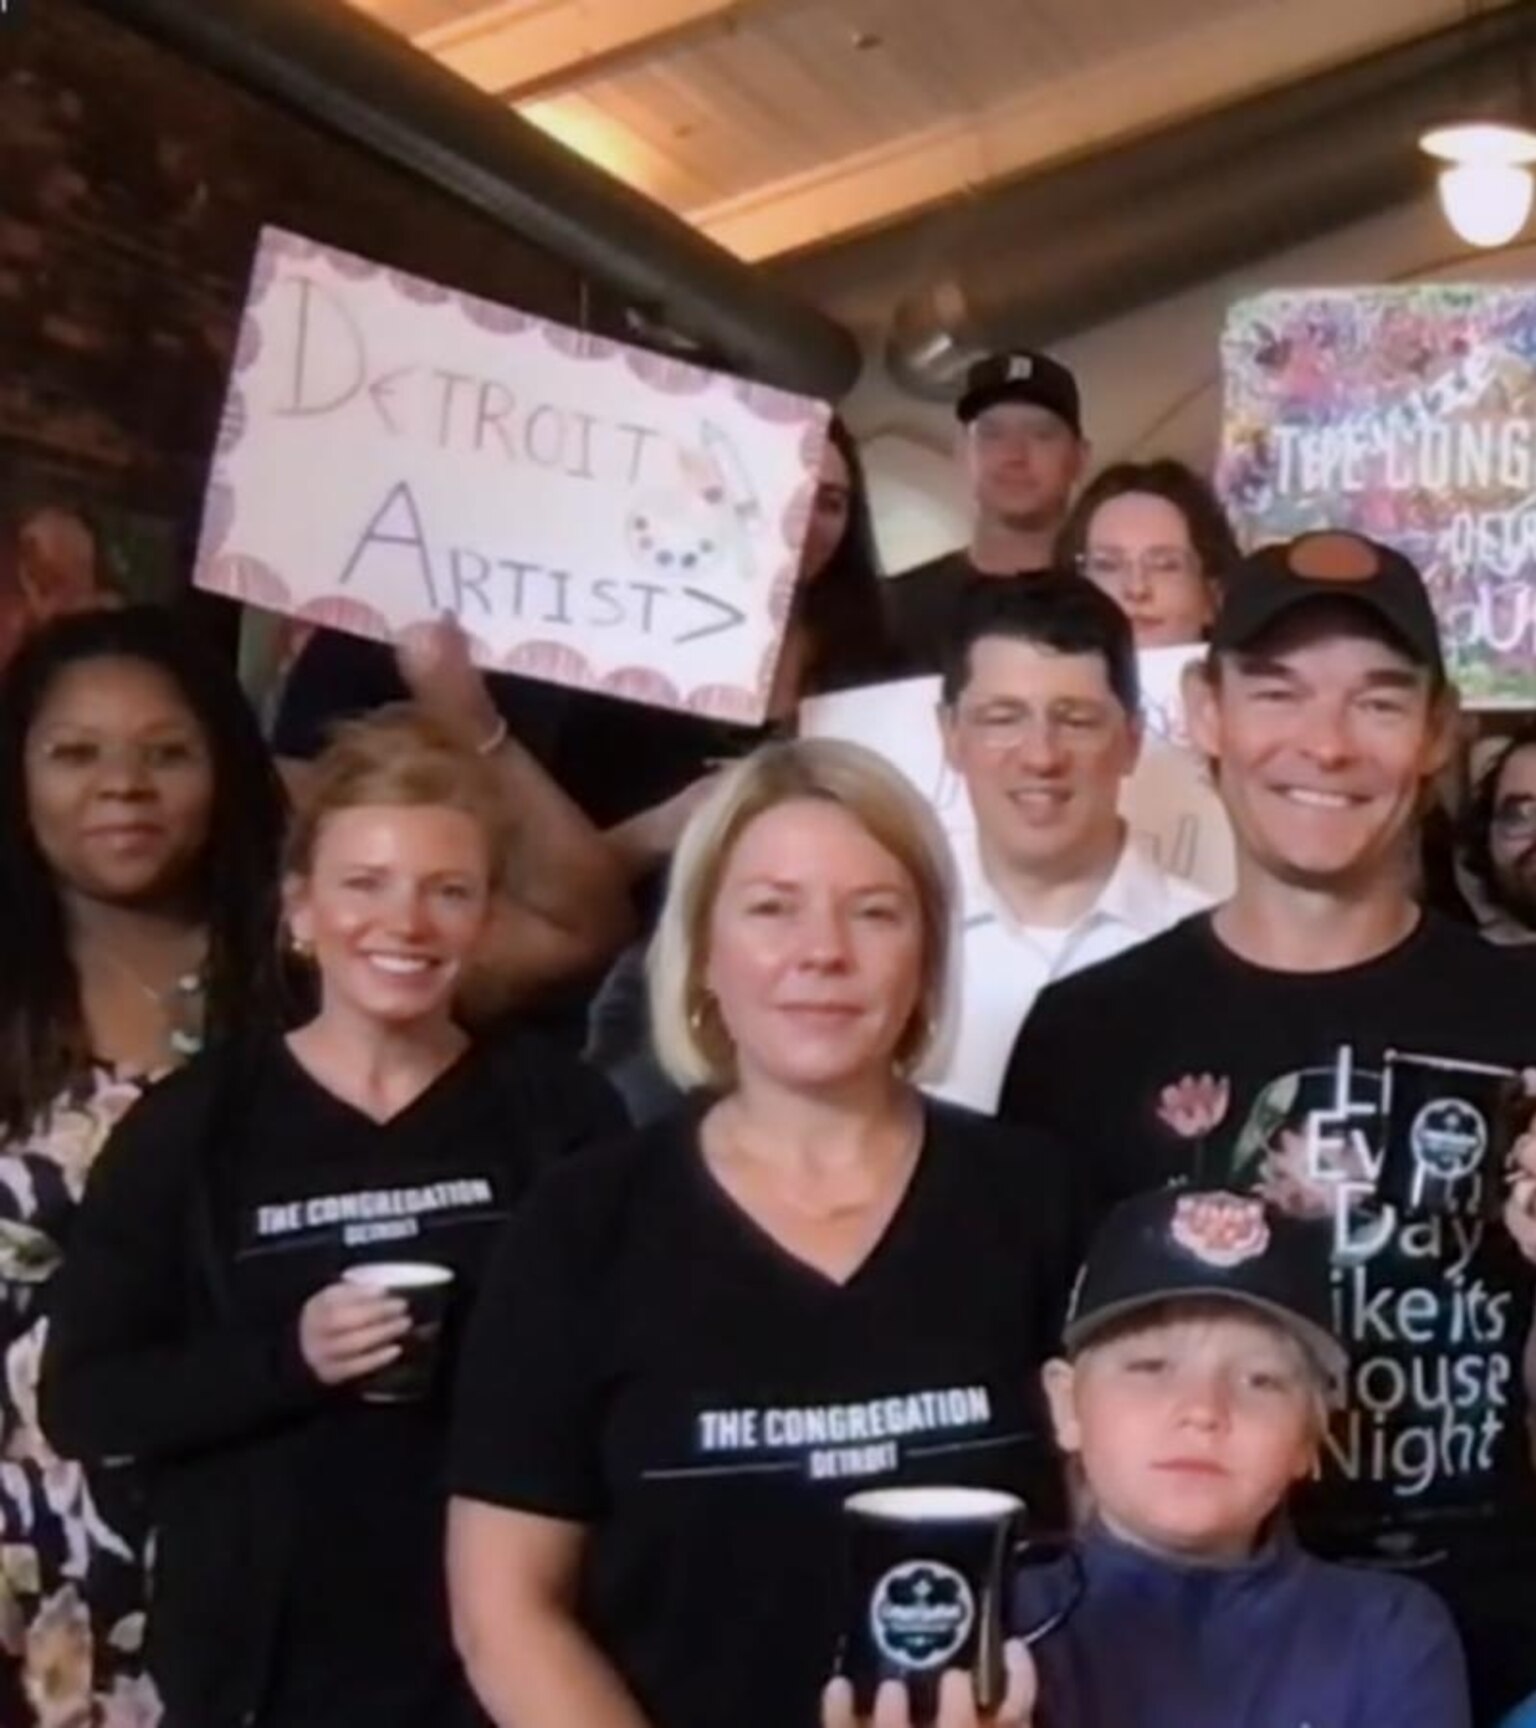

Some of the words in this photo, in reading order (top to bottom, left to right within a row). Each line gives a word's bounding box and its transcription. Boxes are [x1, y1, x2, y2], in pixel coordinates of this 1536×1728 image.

[1334, 1182, 1484, 1279] Day
[1329, 1264, 1440, 1342] ike
[1450, 1276, 1513, 1343] its
[1356, 1352, 1511, 1410] ouse
[700, 1411, 757, 1450] THE
[763, 1386, 991, 1447] CONGREGATION
[1312, 1398, 1504, 1496] Night
[809, 1442, 900, 1479] DETROIT
